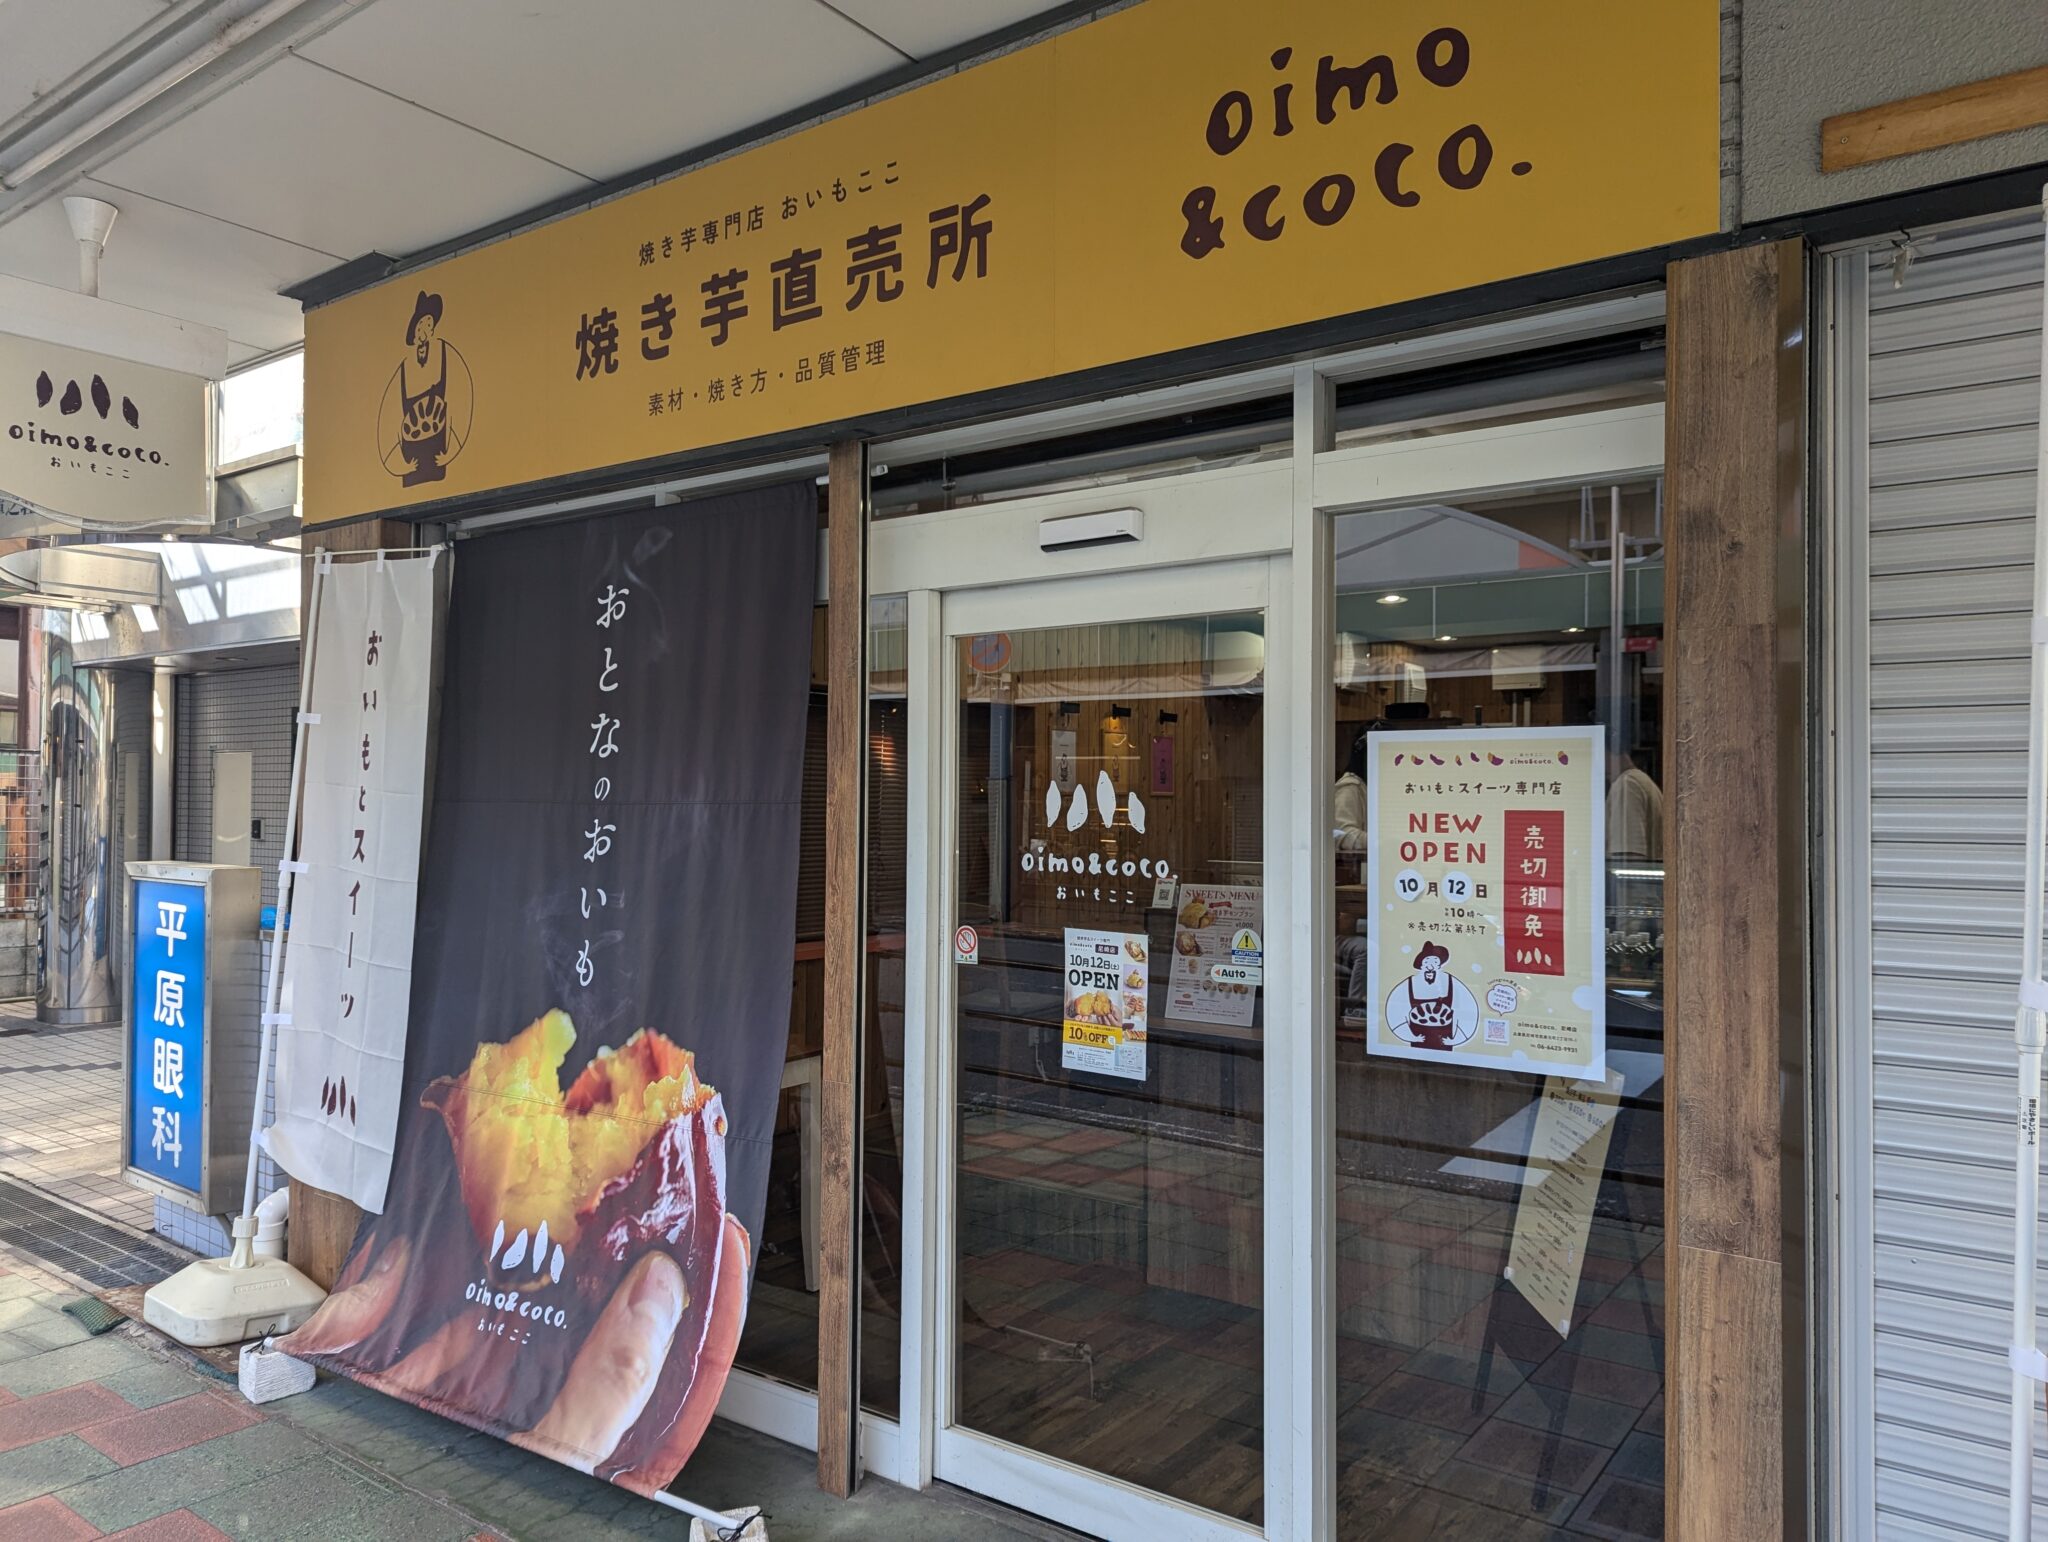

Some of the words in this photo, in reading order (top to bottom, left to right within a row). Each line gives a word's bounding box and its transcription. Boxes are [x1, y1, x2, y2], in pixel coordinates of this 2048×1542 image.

[1205, 26, 1471, 156] oimo
[638, 204, 766, 268] 焼き芋専門店
[780, 160, 900, 219] おいもここ
[1180, 123, 1533, 260] &coco.
[575, 193, 994, 382] 焼き芋直売所
[647, 339, 887, 417] 素材・焼き方・品質管理
[9, 421, 170, 467] oimo&coco.
[50, 456, 131, 479] おいもここ
[575, 584, 630, 988] おとなのおいも
[1404, 780, 1563, 796] おいもとスイーツ専門店
[340, 629, 383, 1020] おいもとスイーツ
[1400, 840, 1487, 864] OPEN
[1408, 811, 1483, 834] NEW
[1021, 846, 1179, 880] oimo&coco.
[1519, 824, 1548, 939] 売切御免
[1056, 885, 1135, 904] おいもここ
[1068, 969, 1120, 990] OPEN
[1221, 968, 1246, 978] Auto
[151, 900, 188, 1170] 平原眼科
